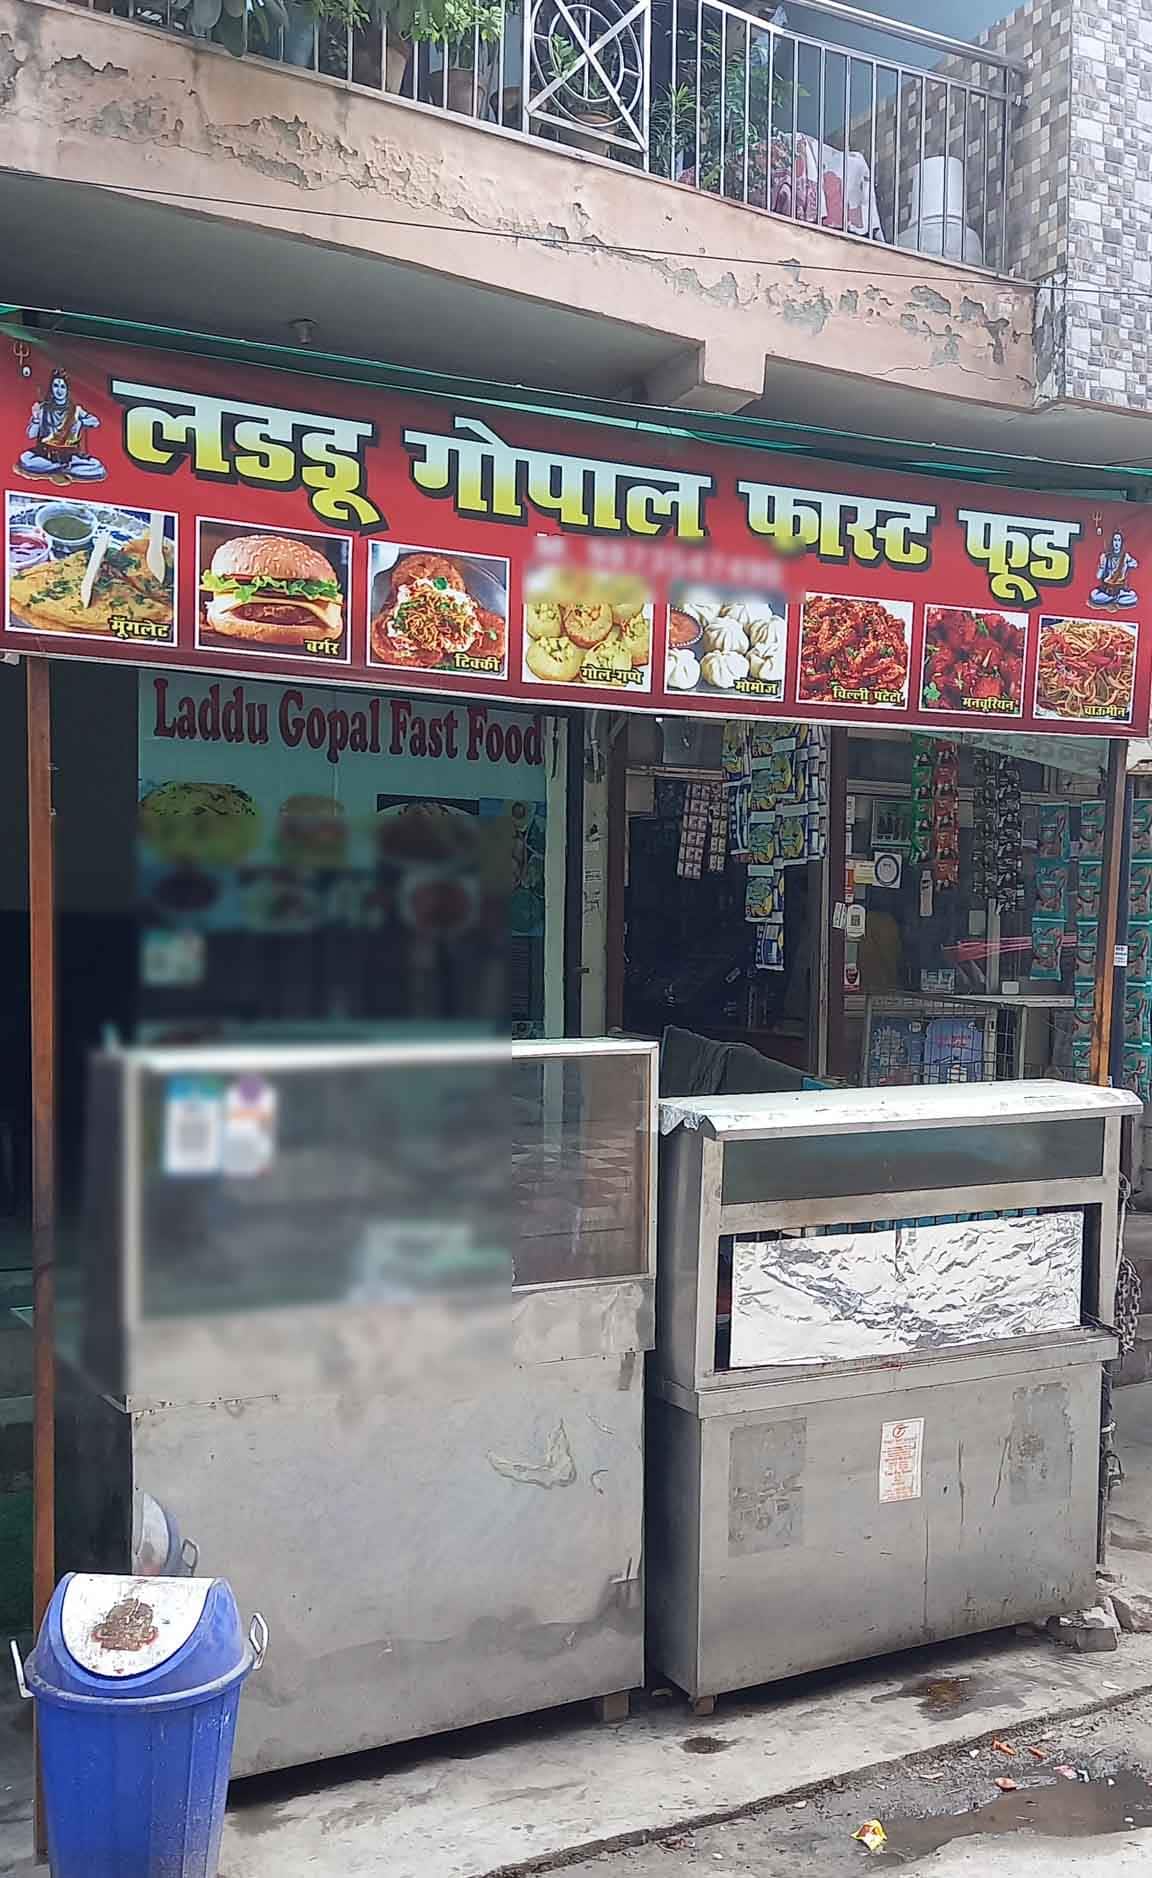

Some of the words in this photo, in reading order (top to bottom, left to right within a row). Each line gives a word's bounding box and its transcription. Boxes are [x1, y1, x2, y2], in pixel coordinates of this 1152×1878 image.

[404, 416, 713, 540] गोपाल
[738, 480, 937, 568] फास्ट
[957, 509, 1081, 602] फूड
[154, 678, 268, 744] Laddu
[279, 690, 380, 763] Gopal
[390, 699, 459, 759] Fast
[466, 706, 542, 765] Food
